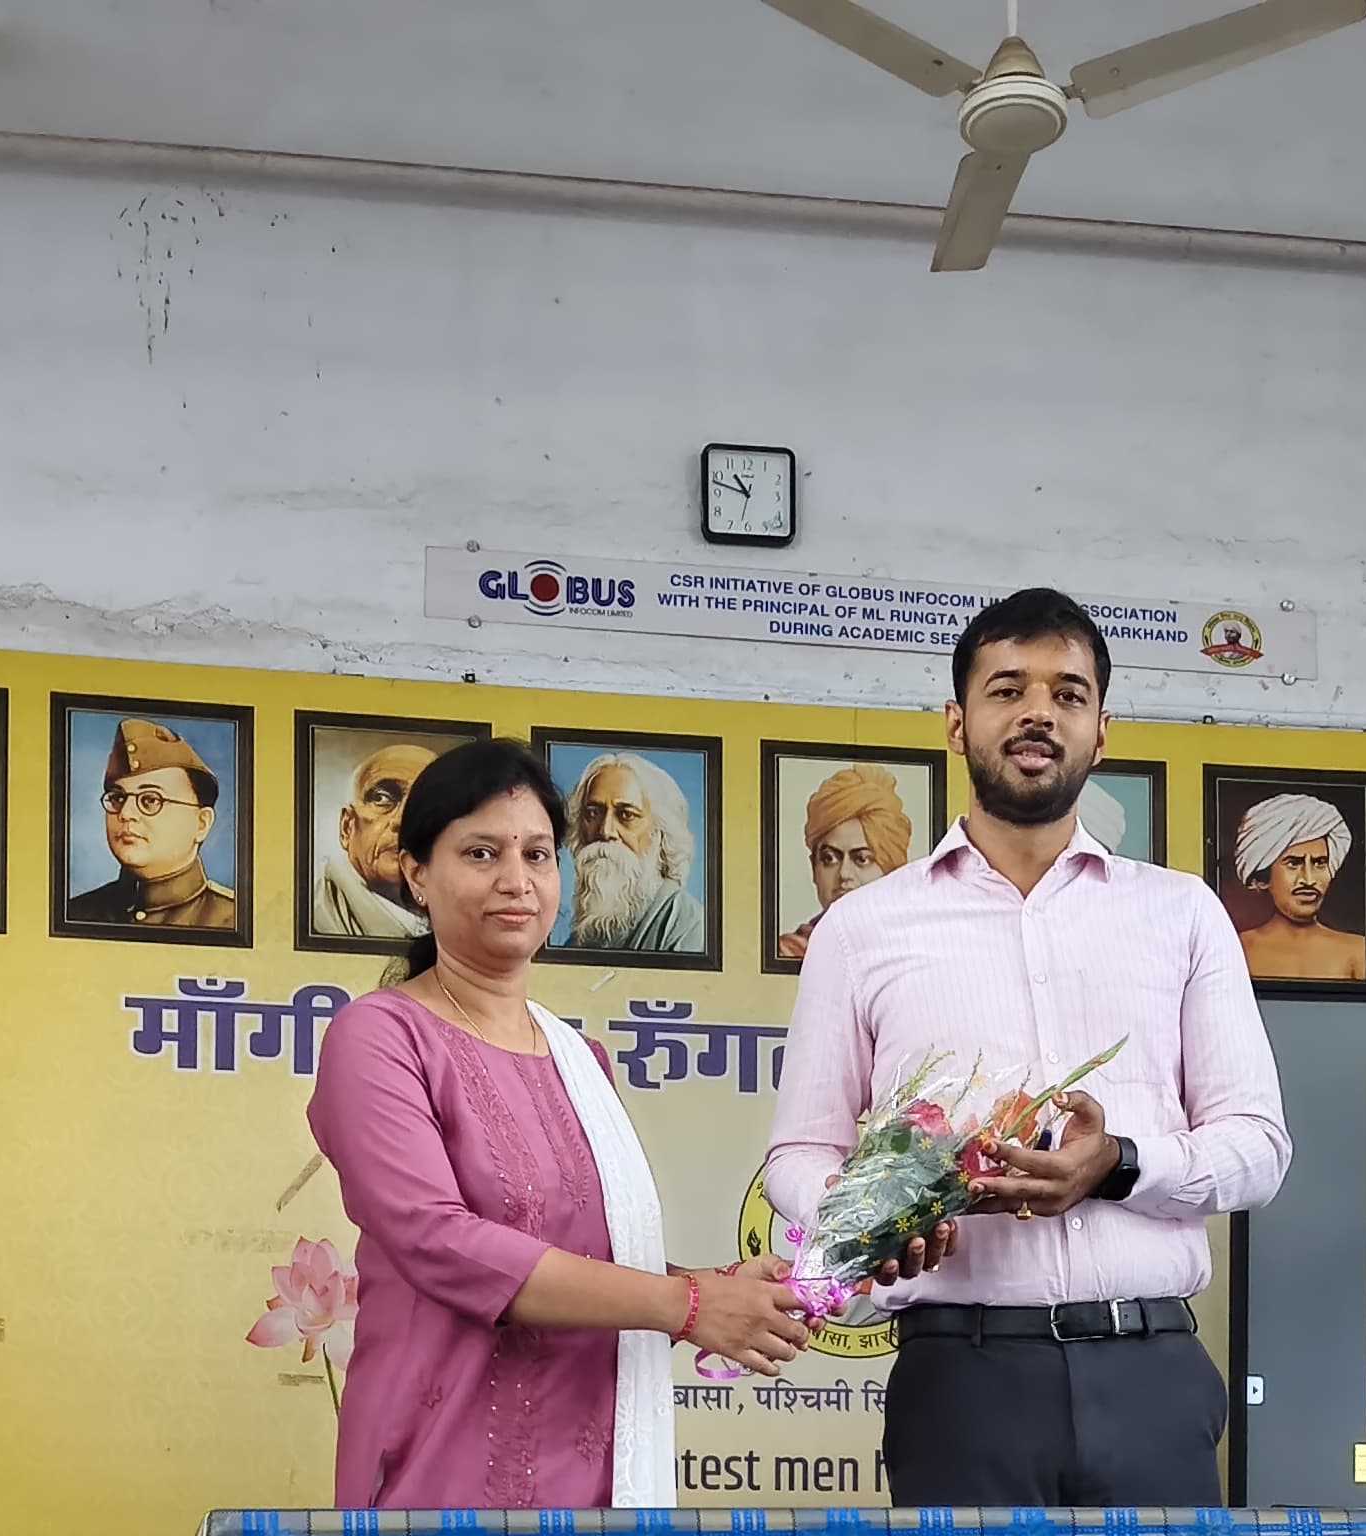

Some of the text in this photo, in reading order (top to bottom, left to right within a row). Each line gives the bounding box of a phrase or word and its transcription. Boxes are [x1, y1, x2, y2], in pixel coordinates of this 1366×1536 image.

[479, 566, 636, 610] GLOBUS
[669, 573, 705, 589] CSR
[709, 576, 794, 596] INITIATIVE
[798, 582, 821, 597] OF
[825, 584, 895, 603] GLOBUS
[899, 590, 976, 609] INFOCOM
[657, 592, 700, 609] WITH
[704, 595, 737, 611] THE
[742, 598, 831, 618] PRINCIPAL
[834, 605, 858, 620] OF
[861, 606, 886, 622] ML
[889, 609, 959, 627] RUNGTA
[1080, 603, 1178, 624] SSOCIATION
[769, 620, 962, 646] DURING ACADEMIC SES
[1097, 624, 1189, 643] HARKHAND
[673, 1385, 745, 1415] बासा,
[753, 1378, 854, 1414] पश्चिमी
[676, 1449, 762, 1492] test
[774, 1455, 860, 1492] men
